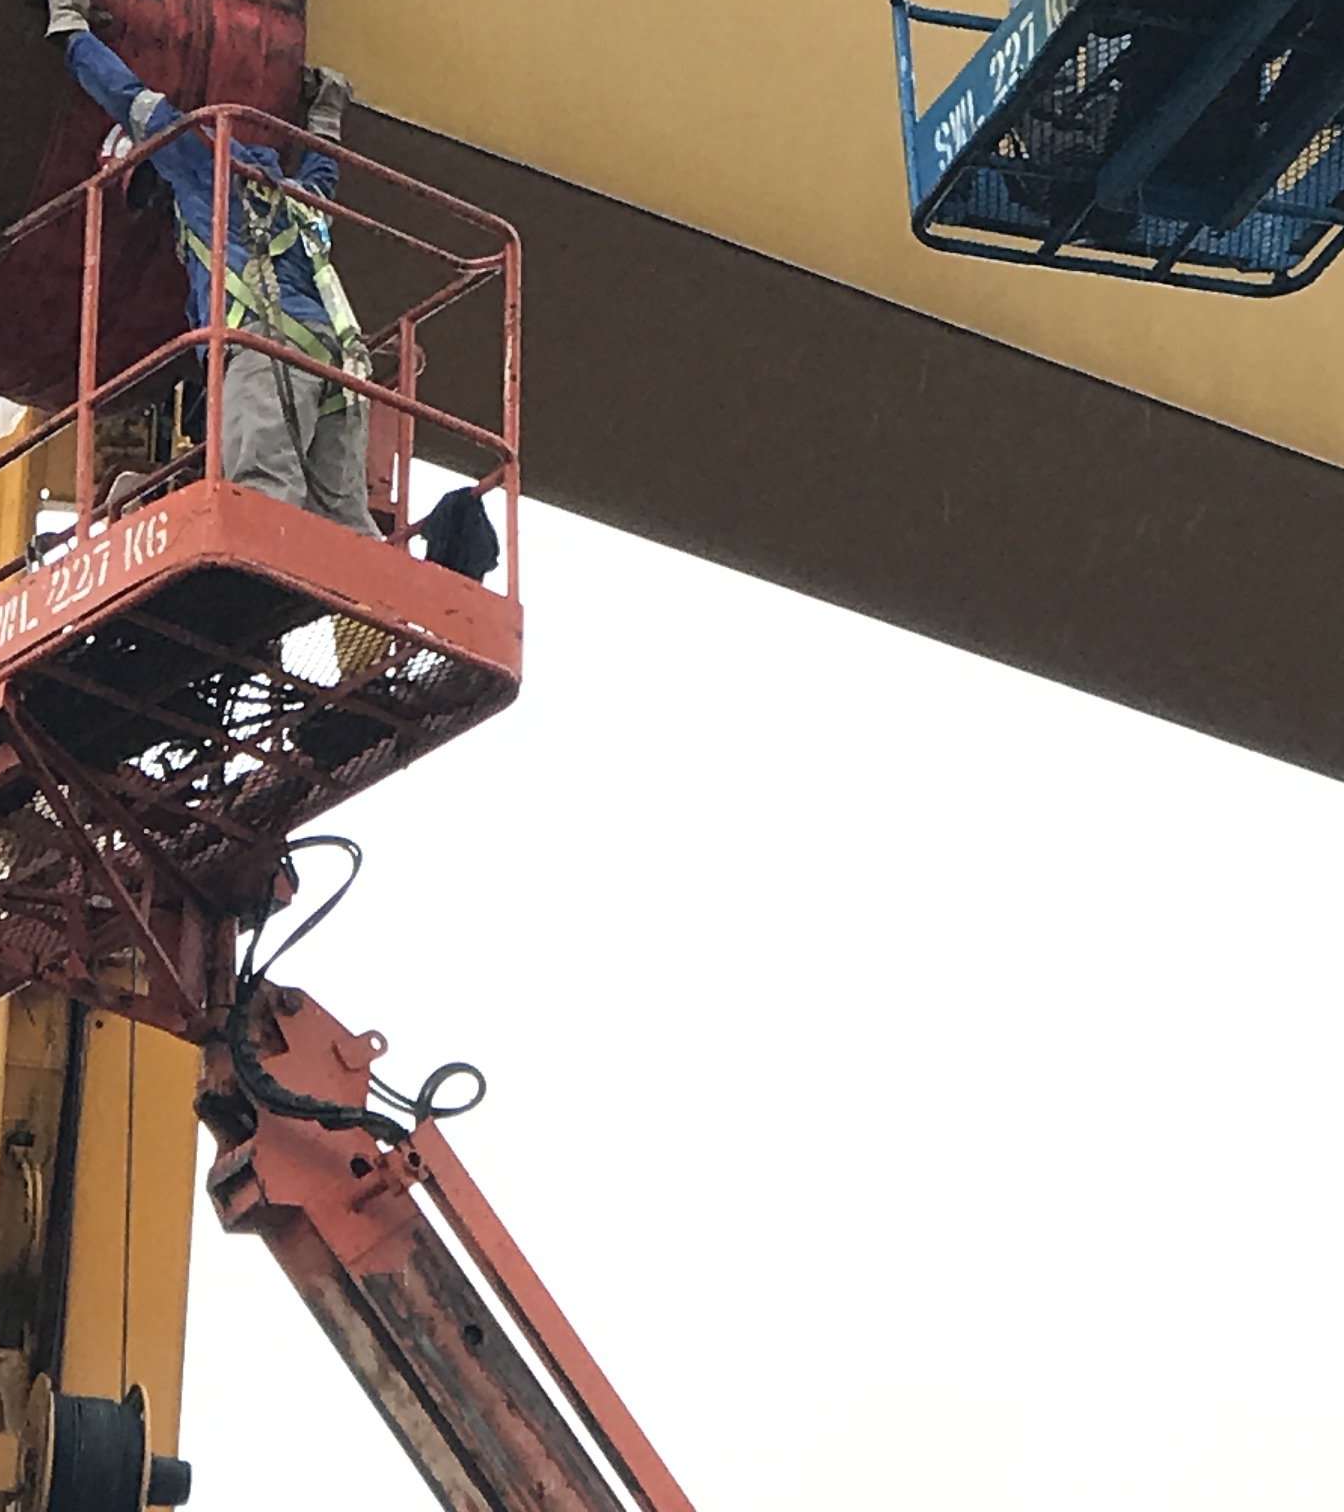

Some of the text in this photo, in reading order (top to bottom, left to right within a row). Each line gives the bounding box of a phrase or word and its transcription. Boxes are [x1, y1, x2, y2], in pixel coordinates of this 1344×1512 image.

[934, 89, 986, 172] SWL
[989, 11, 1035, 107] 227
[45, 539, 112, 616] 227
[123, 510, 169, 573] KG
